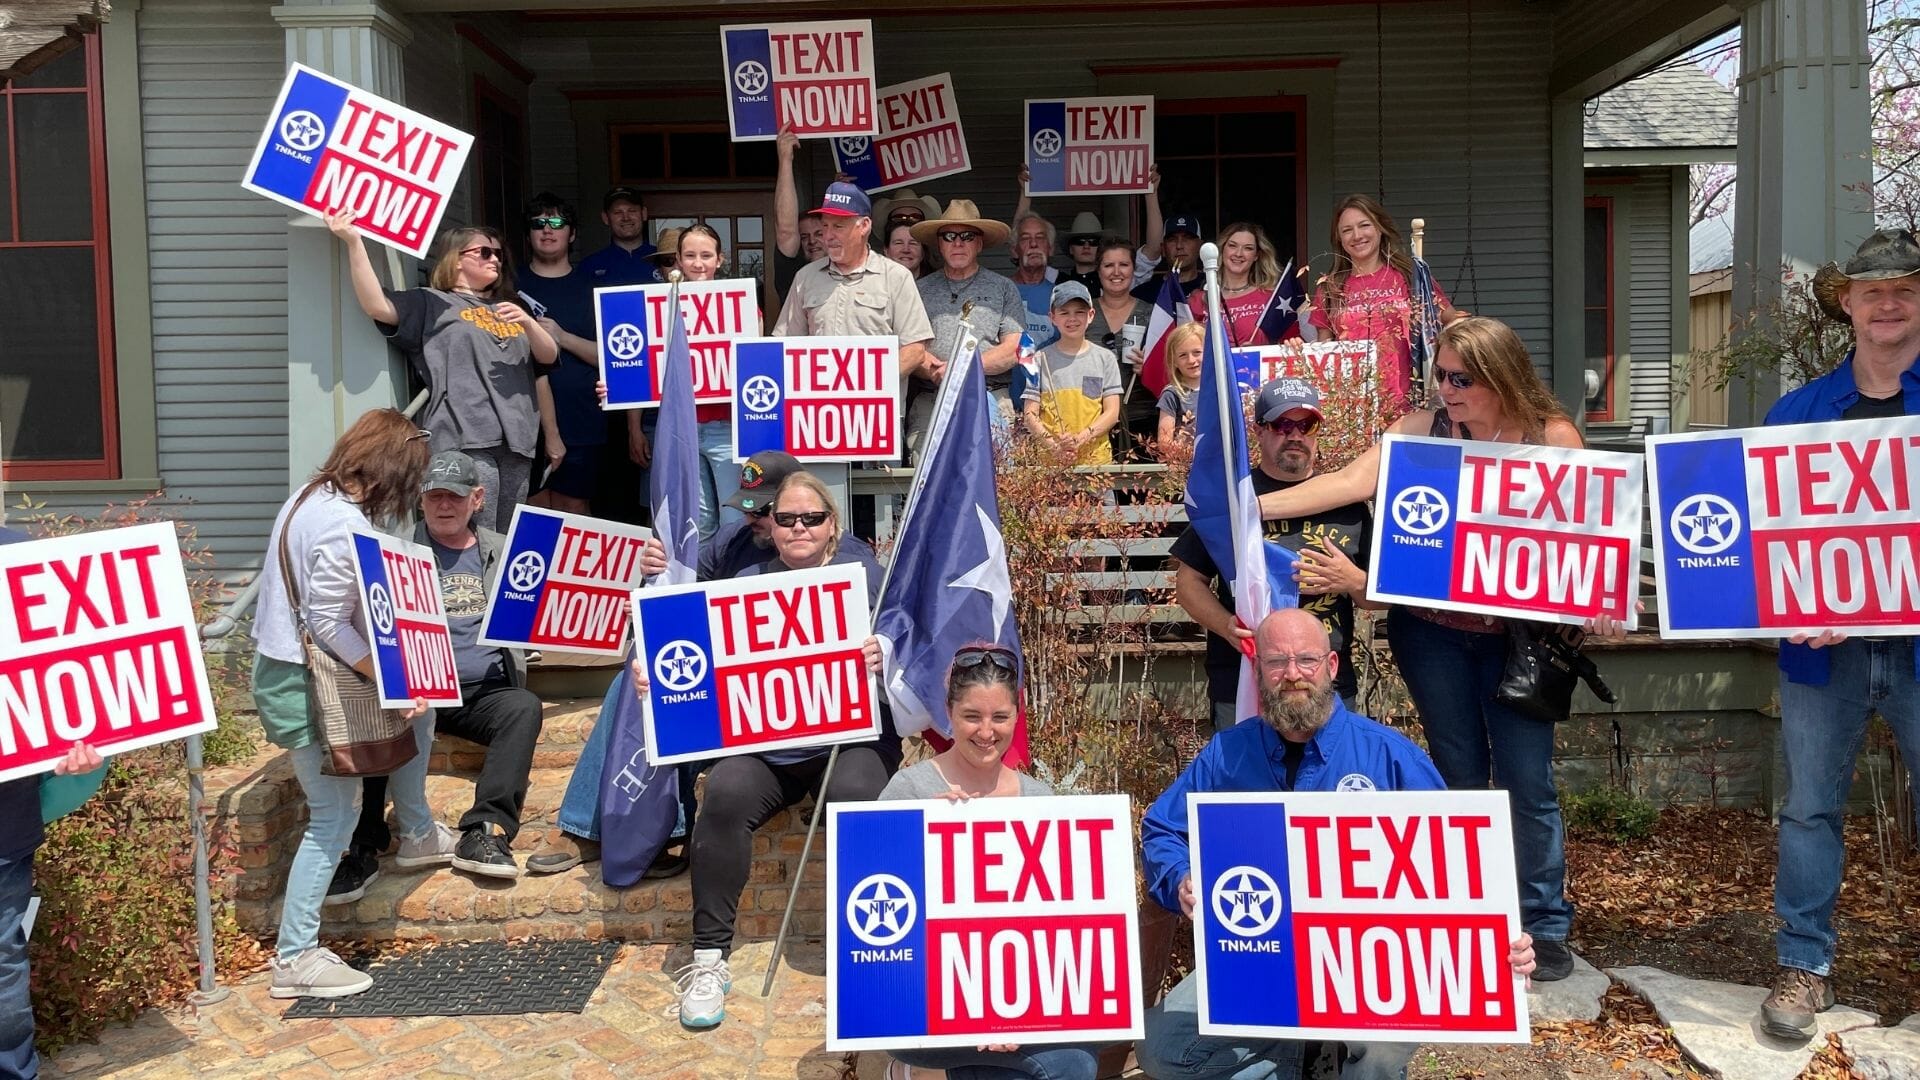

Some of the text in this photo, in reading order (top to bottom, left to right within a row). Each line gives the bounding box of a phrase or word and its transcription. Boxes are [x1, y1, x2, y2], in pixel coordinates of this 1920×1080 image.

[771, 31, 863, 75] TEXIT
[738, 95, 768, 103] TNM.ME
[780, 84, 867, 127] NOW!
[340, 98, 459, 183] TEXIT
[1067, 105, 1146, 141] TEXIT
[275, 143, 313, 165] TNM.ME
[845, 155, 871, 165] TNM.ME
[880, 128, 959, 180] NOW!
[1070, 150, 1144, 185] NOW!
[313, 157, 433, 241] NOW!
[611, 359, 643, 369] TNM.ME
[785, 348, 889, 391] TEXIT
[1273, 384, 1312, 395] mess with
[1282, 391, 1306, 399] Texas
[744, 413, 778, 421] TNM.ME
[792, 404, 888, 449] NOW!
[432, 460, 461, 475] 2A
[1748, 436, 1920, 517] TEXI
[1464, 455, 1627, 527] TEXIT
[557, 526, 645, 583] TEXIT
[1303, 521, 1350, 547] BACK
[1392, 534, 1443, 548] TNM.ME
[383, 549, 439, 615] TEXIT
[1462, 532, 1618, 609] NOW!
[1677, 556, 1740, 568] TNM.ME
[1768, 536, 1920, 615] NOW
[5, 544, 161, 643] EXIT
[504, 591, 535, 602] TNM.ME
[538, 589, 625, 642] NOW!
[710, 581, 851, 656] TEXIT
[400, 628, 455, 690] NOW!
[0, 640, 188, 755] NOW!
[661, 690, 708, 704] TNM.ME
[726, 659, 862, 737] NOW!
[928, 818, 1114, 904] TEXIT
[1289, 815, 1491, 899] TEXIT
[850, 949, 913, 963] TNM.ME
[1218, 939, 1280, 952] TNM.ME
[940, 927, 1118, 1020] NOW!
[1308, 926, 1501, 1016] NOW!
